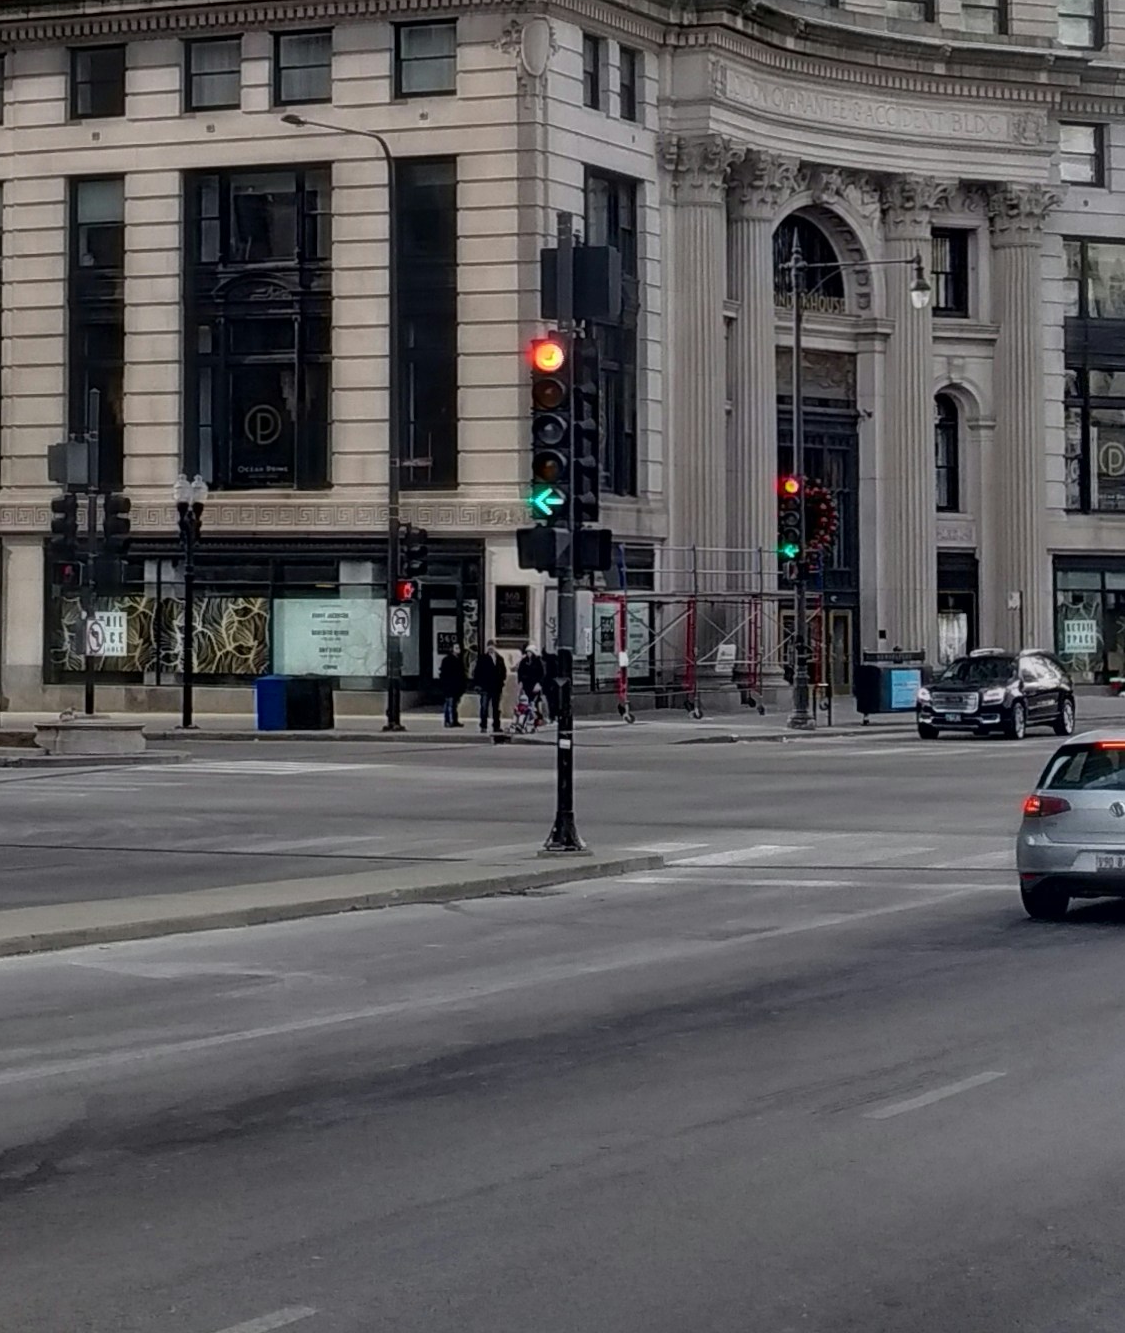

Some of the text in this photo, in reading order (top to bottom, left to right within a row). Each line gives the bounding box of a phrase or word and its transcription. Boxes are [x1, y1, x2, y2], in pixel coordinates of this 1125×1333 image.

[951, 112, 1002, 134] BLDG
[1066, 623, 1094, 633] RETAIL
[1067, 634, 1094, 644] SPACE
